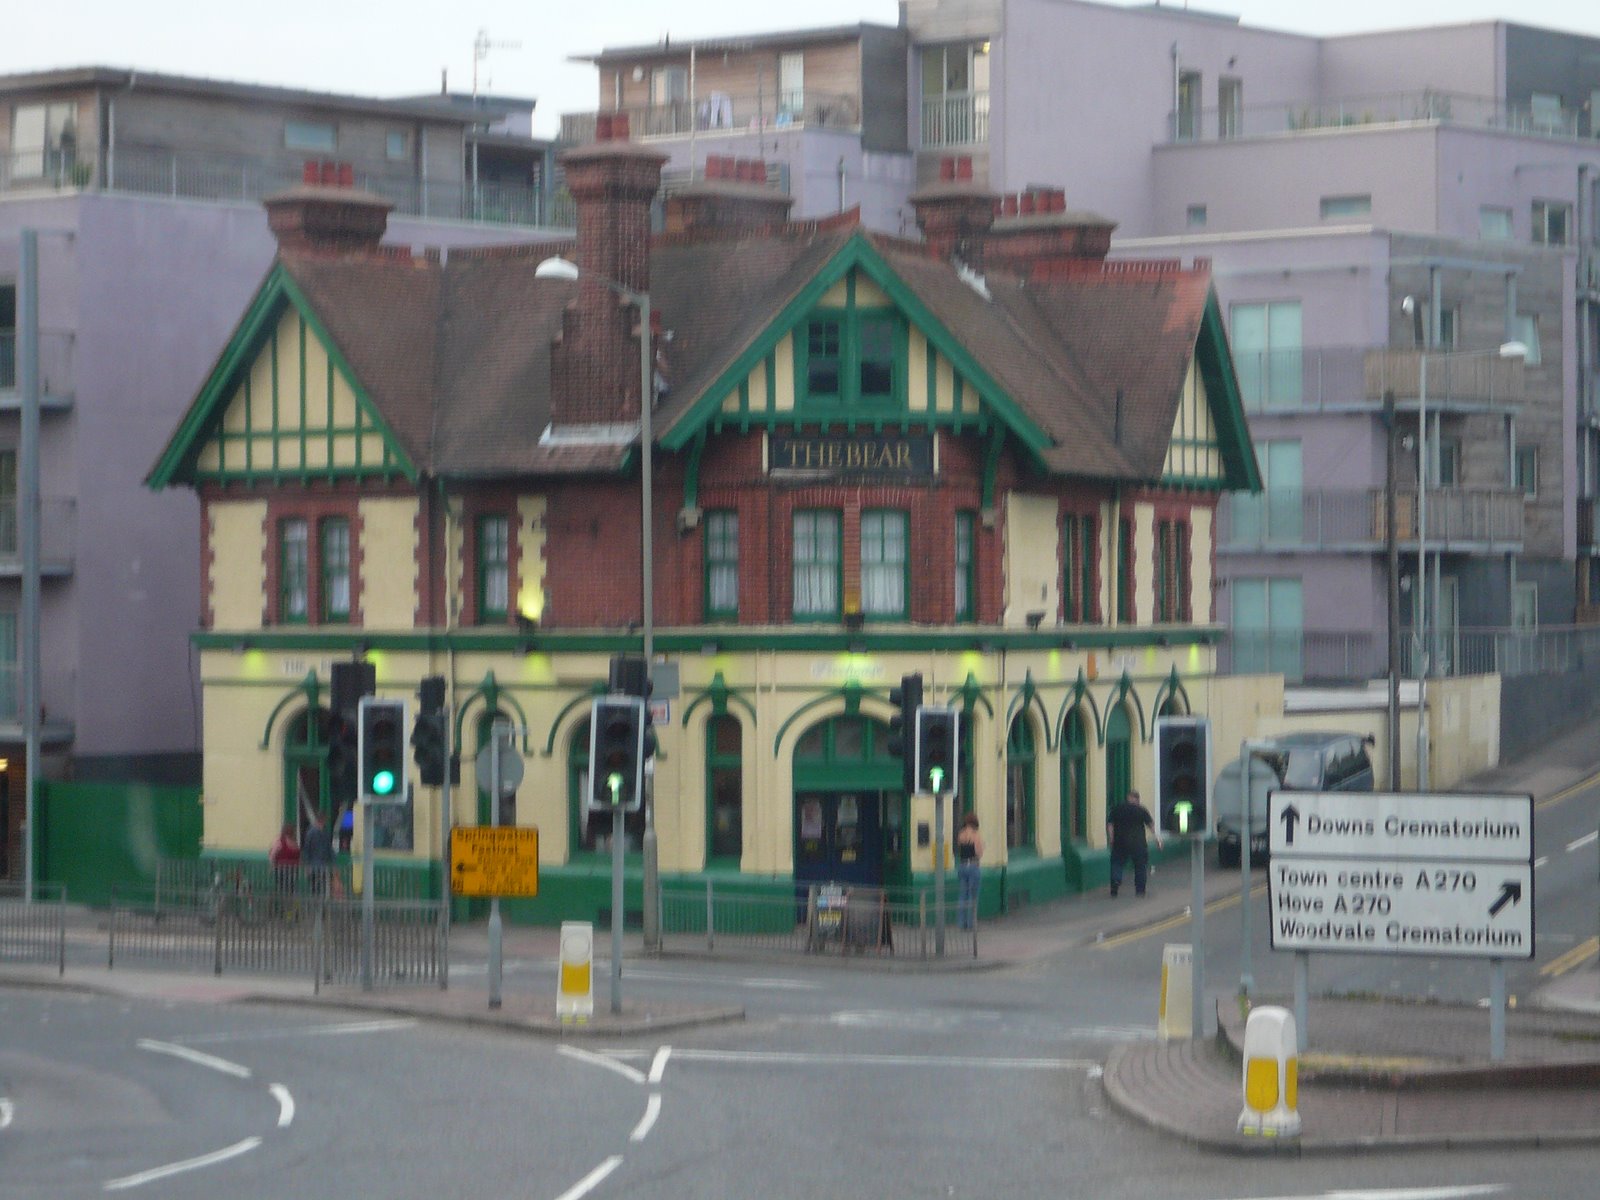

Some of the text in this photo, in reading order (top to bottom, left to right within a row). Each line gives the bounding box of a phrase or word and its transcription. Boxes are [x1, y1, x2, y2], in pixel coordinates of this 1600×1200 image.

[784, 440, 912, 468] THE BEAR
[456, 829, 534, 843] Springwatch
[1308, 814, 1520, 839] Downs Crematorium
[471, 844, 519, 855] Festival
[1278, 865, 1328, 887] Town
[1338, 868, 1404, 890] centre
[1278, 893, 1324, 914] Hove
[1280, 919, 1522, 947] Woodvale Crematorium
